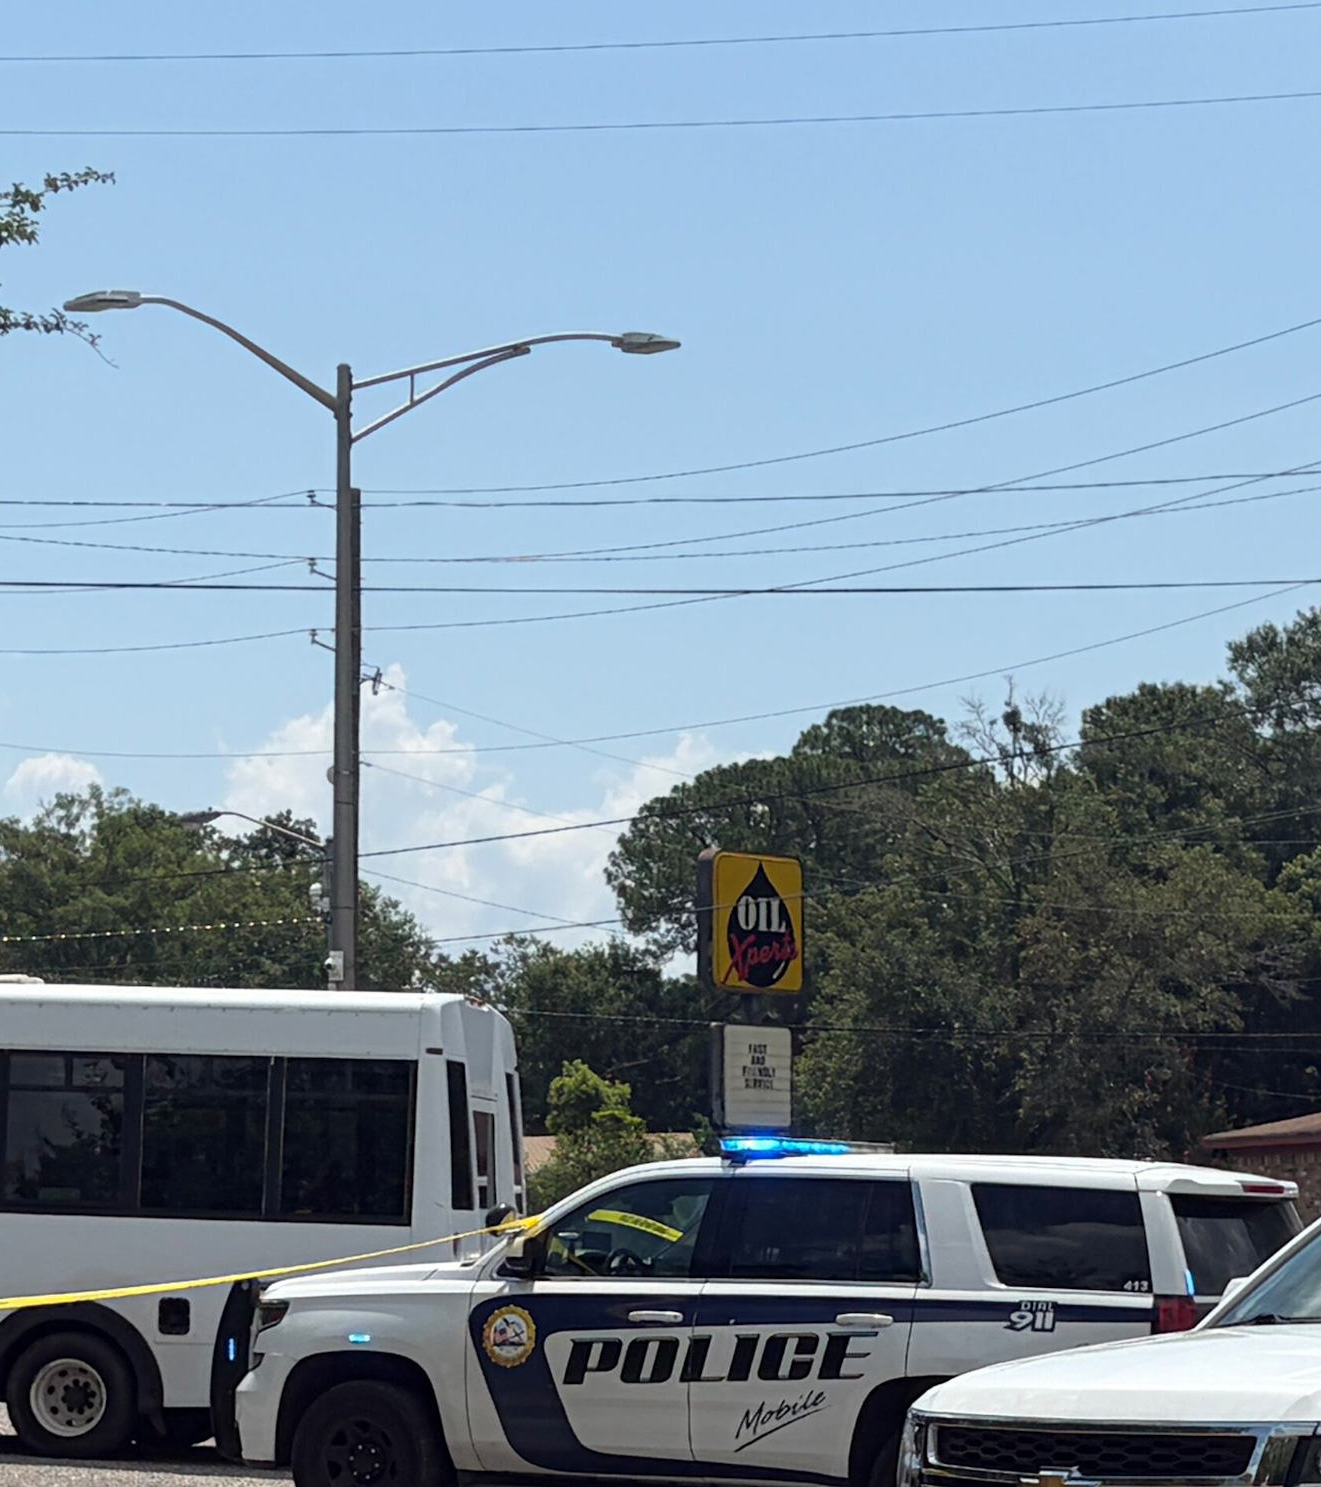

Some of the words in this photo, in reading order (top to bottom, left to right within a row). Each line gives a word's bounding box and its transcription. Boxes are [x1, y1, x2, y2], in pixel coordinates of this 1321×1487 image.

[737, 895, 786, 933] OIL
[1123, 1280, 1149, 1292] 413
[1009, 1310, 1055, 1331] 911
[1021, 1300, 1055, 1312] DIAL
[561, 1331, 879, 1385] POLICE
[734, 1390, 829, 1440] Mobile
